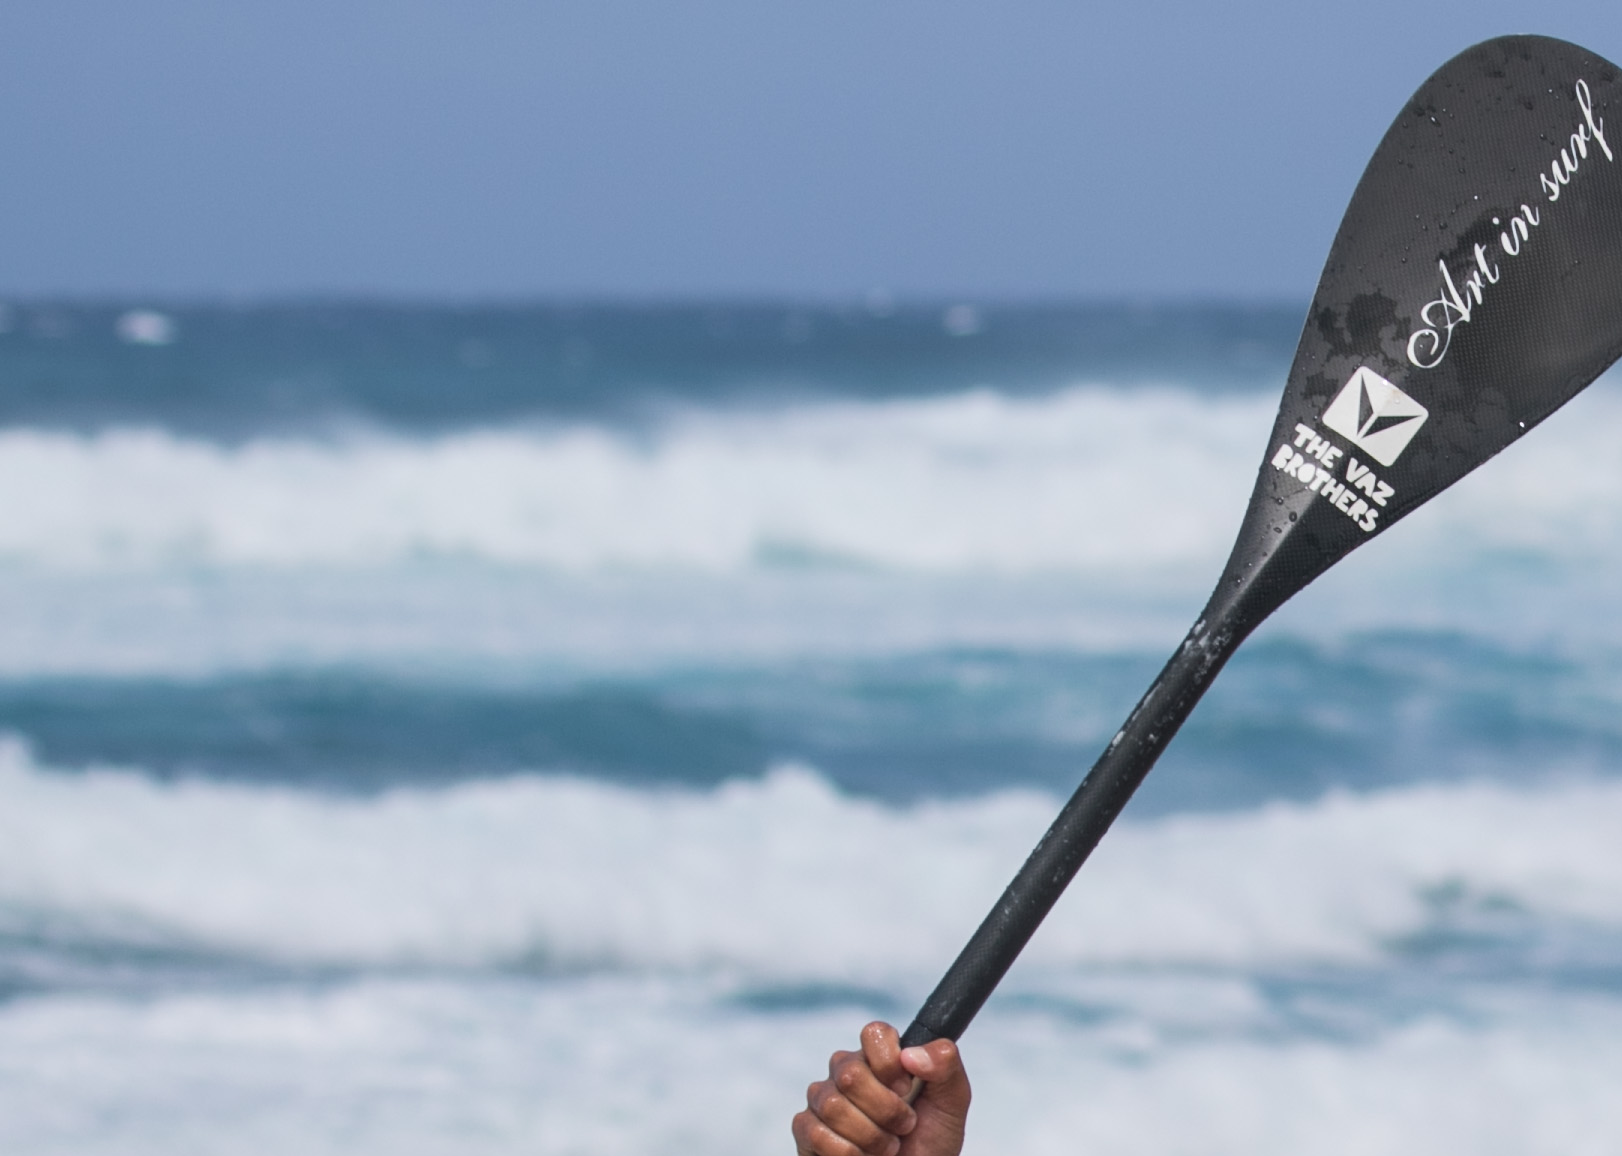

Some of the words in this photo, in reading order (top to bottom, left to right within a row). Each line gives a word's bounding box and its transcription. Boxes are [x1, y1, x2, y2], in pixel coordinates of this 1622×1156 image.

[1407, 242, 1499, 369] Art
[1492, 204, 1540, 256] in
[1540, 78, 1614, 202] surf
[1271, 443, 1379, 532] BROTHERS
[1293, 422, 1344, 469] THE
[1345, 456, 1396, 507] VAZ
